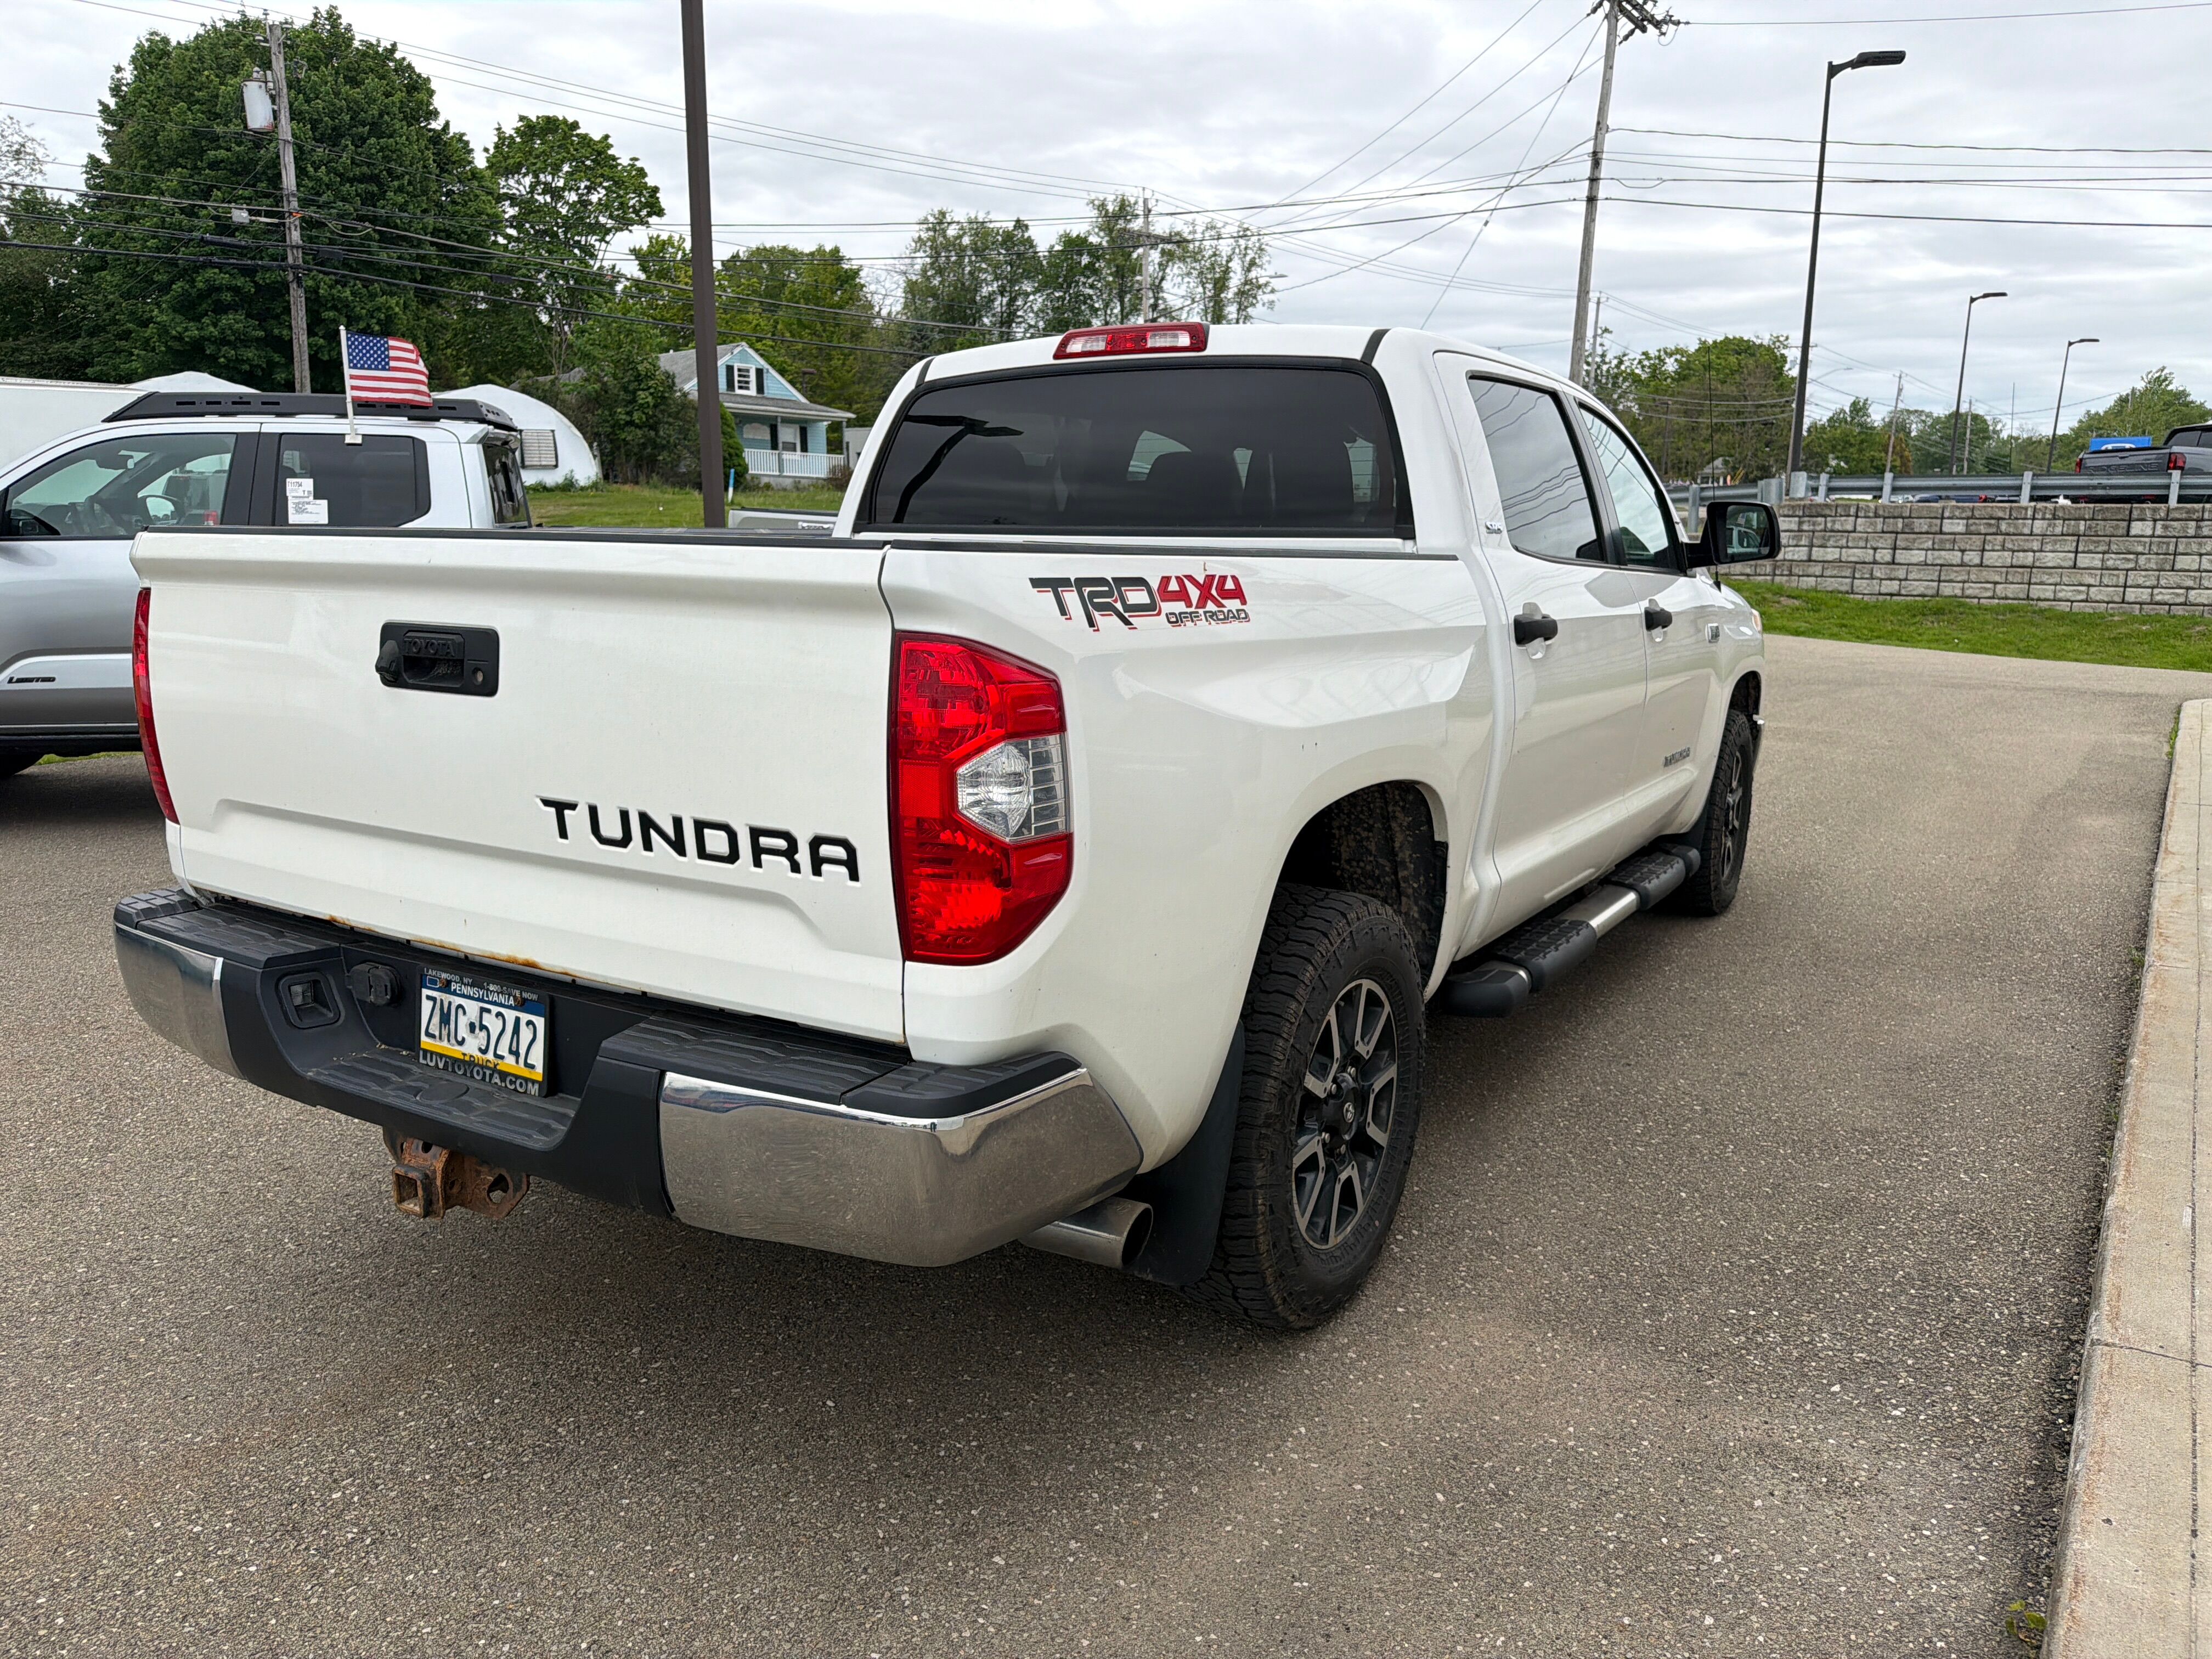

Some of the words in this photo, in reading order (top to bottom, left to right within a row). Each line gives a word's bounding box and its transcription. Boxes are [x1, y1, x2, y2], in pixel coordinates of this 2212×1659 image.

[1029, 577, 1162, 632] TRD
[1165, 612, 1203, 627] OFF
[1204, 608, 1251, 624] ROAD
[404, 638, 455, 657] TOYOTA
[538, 797, 860, 883] TUNDRA
[451, 983, 515, 1006] PENNSYLVANIA
[522, 992, 538, 1001] NOW
[419, 1049, 539, 1096] LUVTOYOTA.COM
